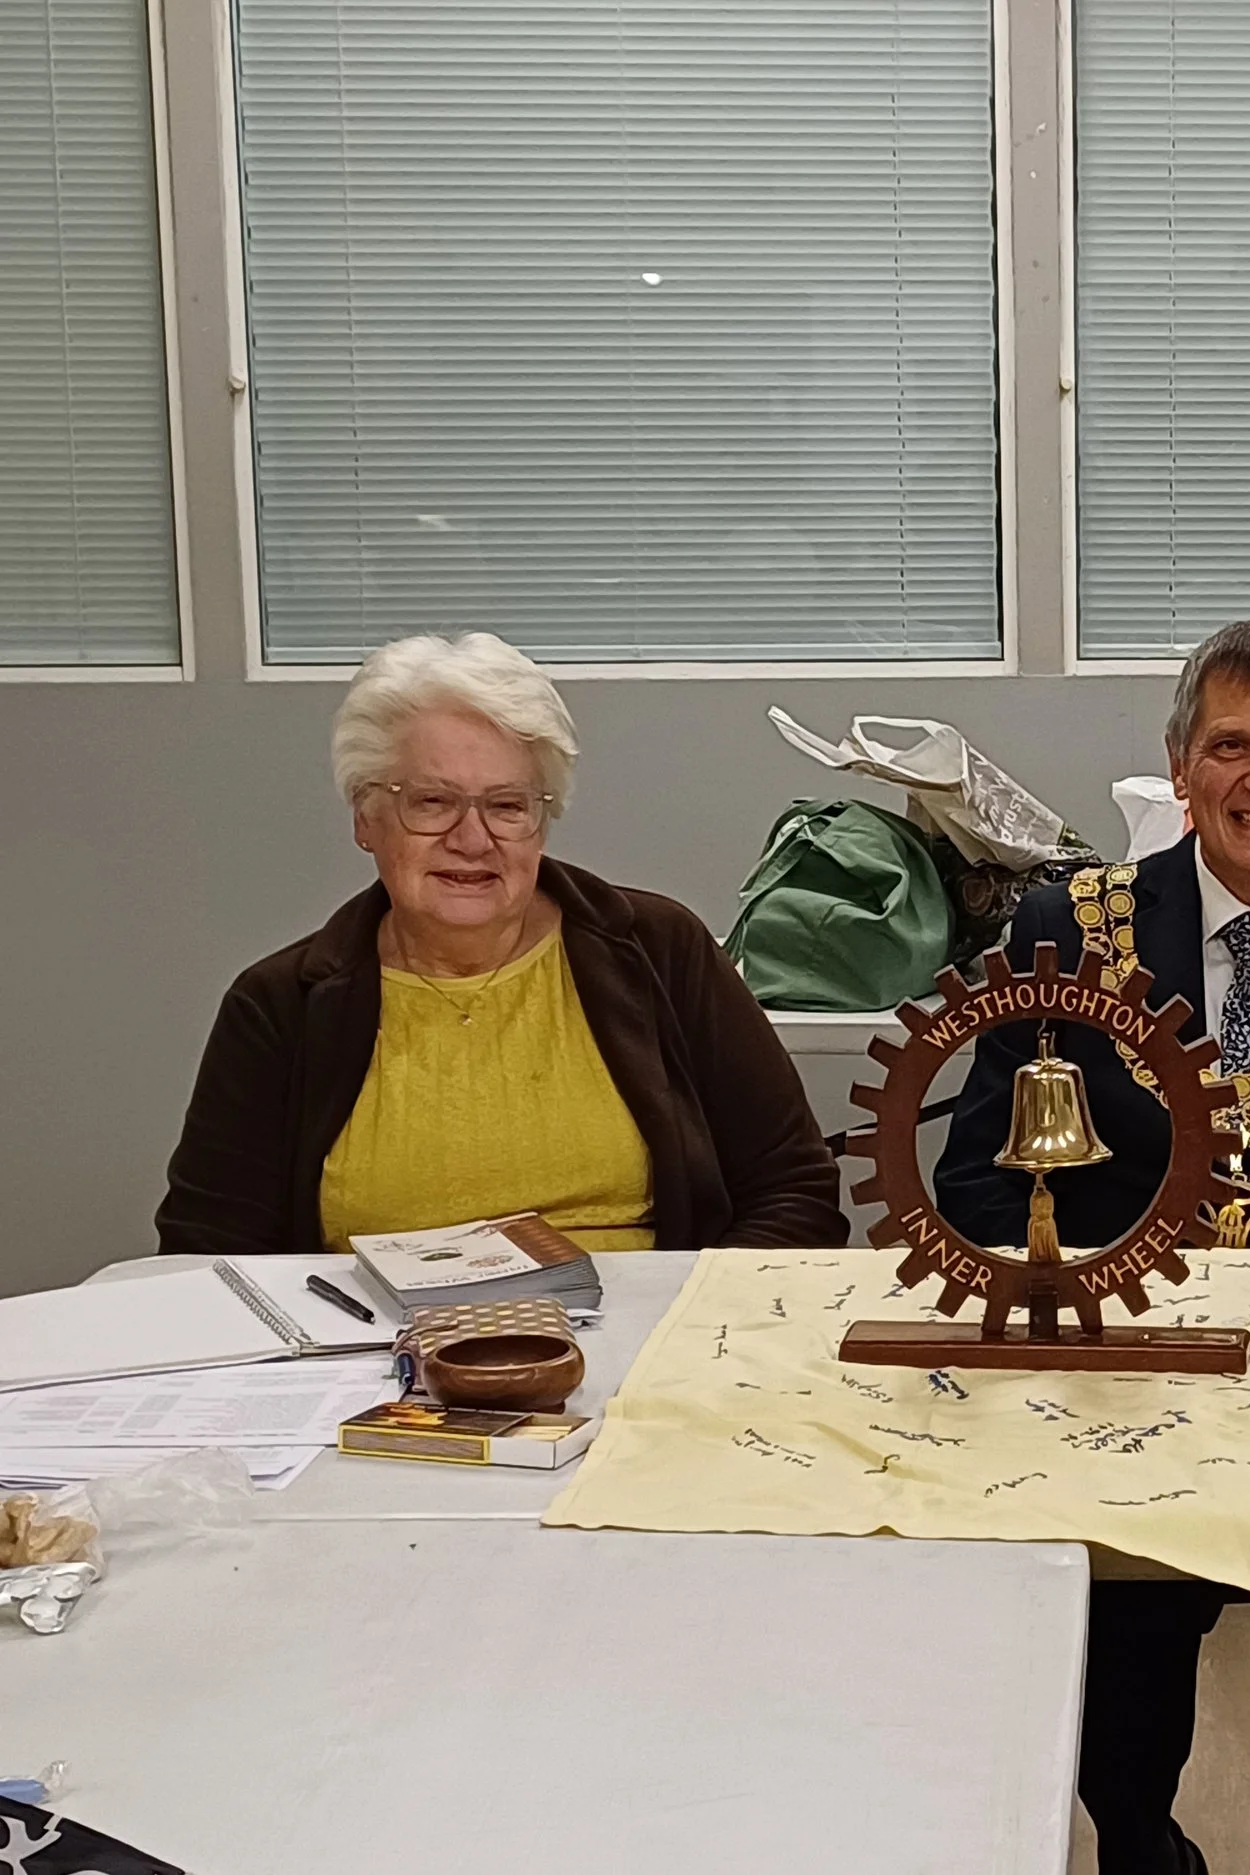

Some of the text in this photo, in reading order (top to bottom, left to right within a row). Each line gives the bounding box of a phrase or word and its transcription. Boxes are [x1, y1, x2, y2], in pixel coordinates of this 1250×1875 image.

[922, 984, 1155, 1049] WESTHOUGHTON
[900, 1207, 1184, 1295] INNER WHEEL
